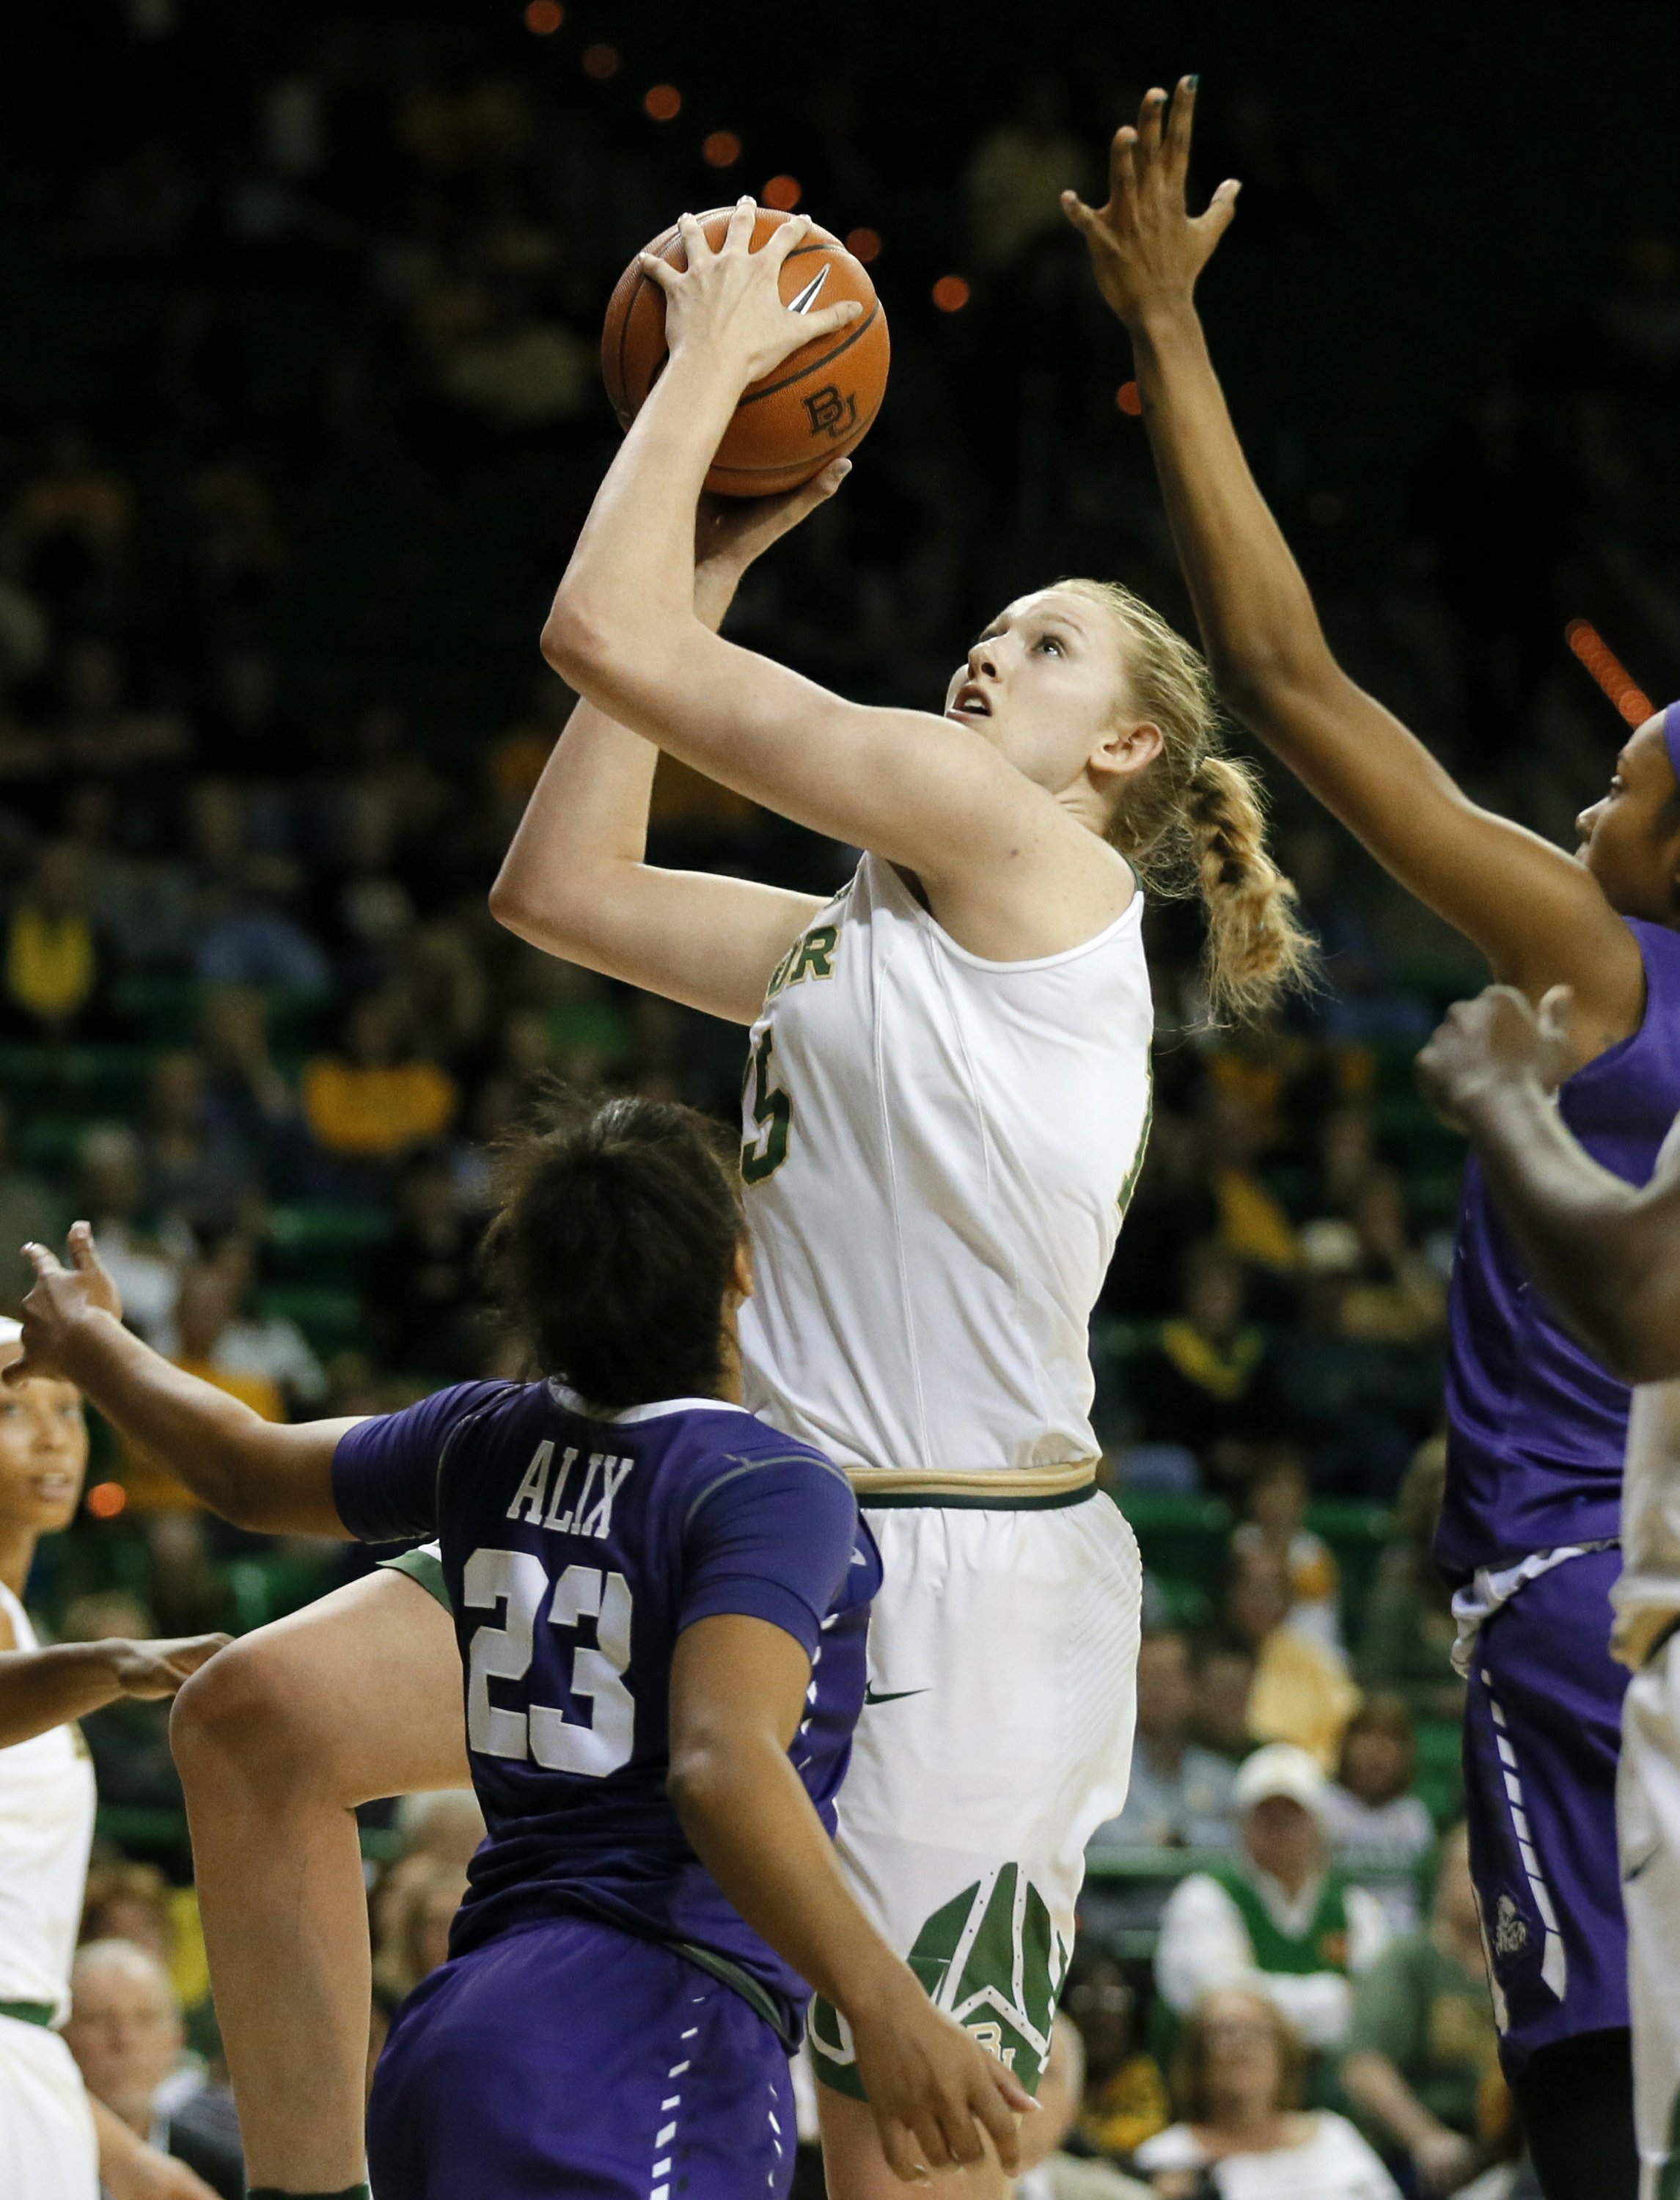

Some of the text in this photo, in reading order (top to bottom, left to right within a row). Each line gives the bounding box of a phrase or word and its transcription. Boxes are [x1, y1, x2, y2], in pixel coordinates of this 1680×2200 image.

[802, 383, 856, 438] BU
[506, 1440, 634, 1539] ALIX
[463, 1547, 636, 1778] 23
